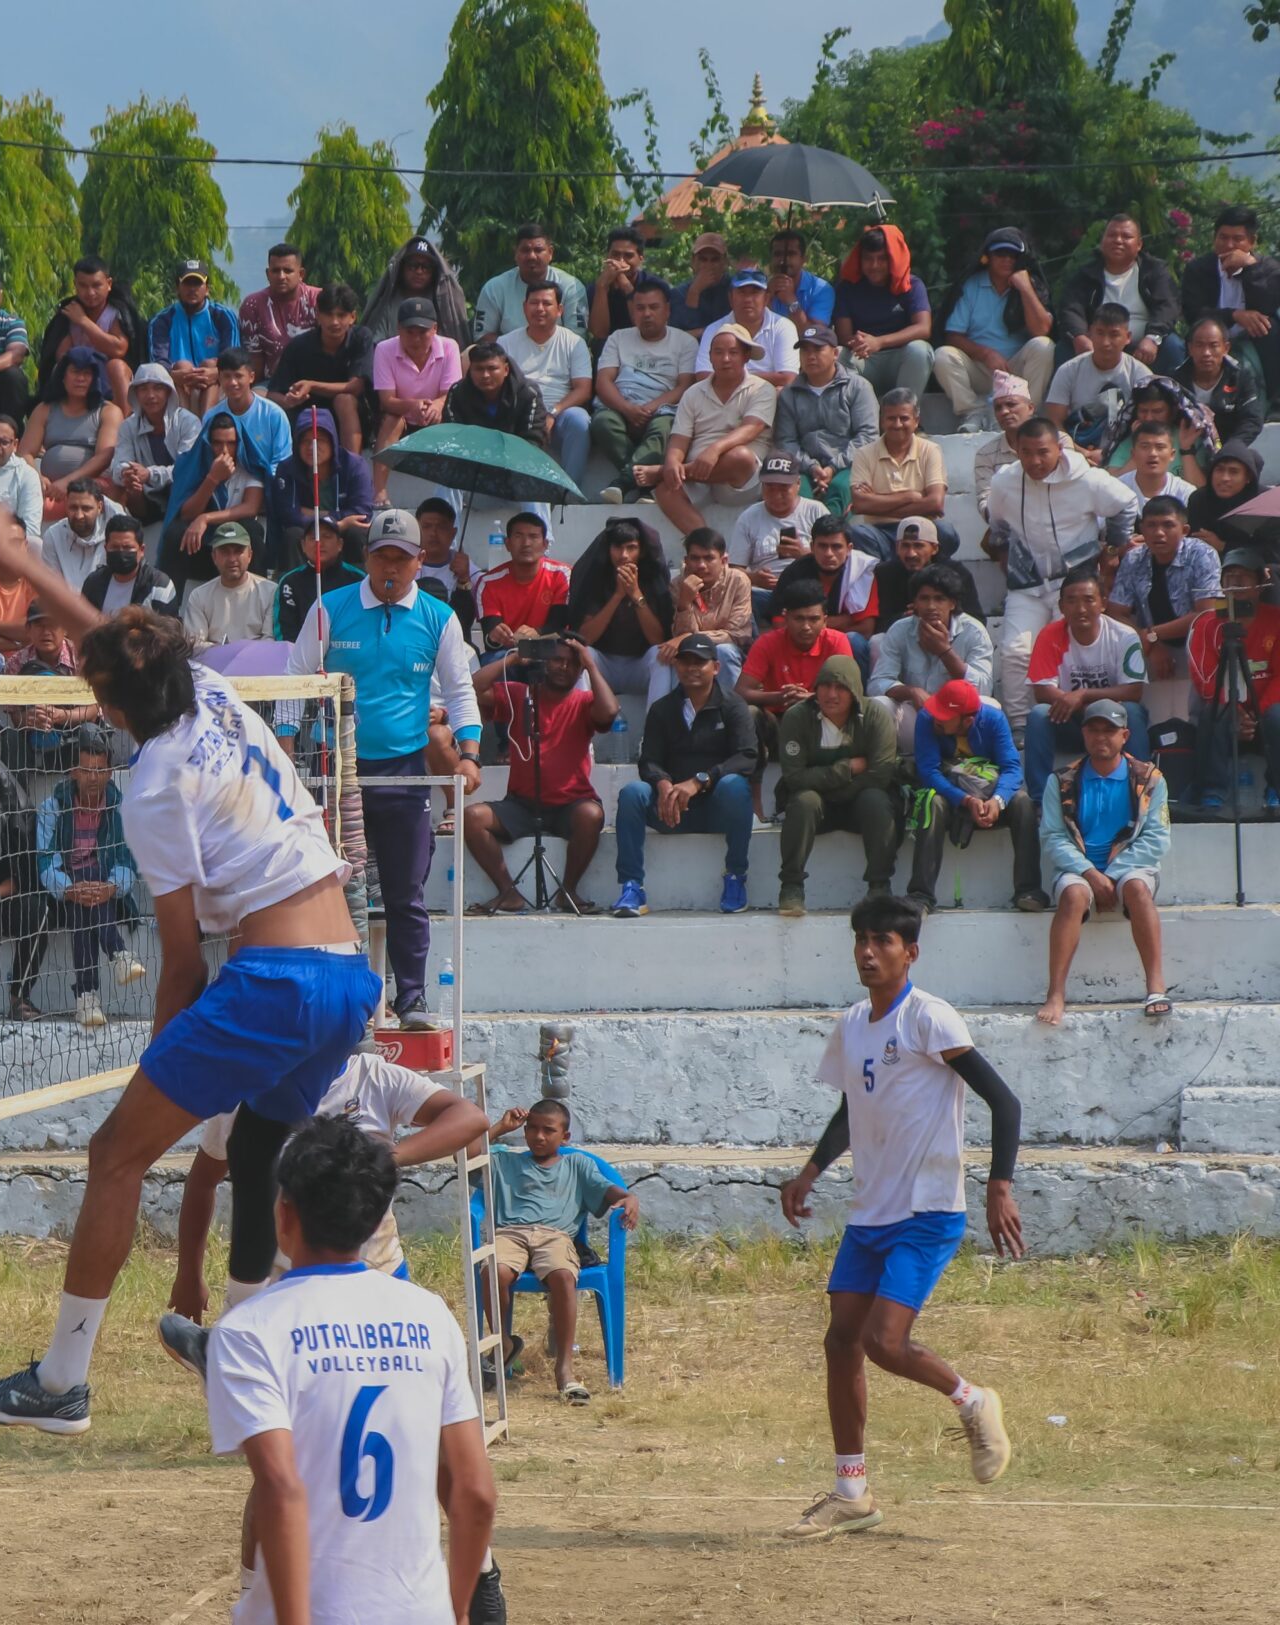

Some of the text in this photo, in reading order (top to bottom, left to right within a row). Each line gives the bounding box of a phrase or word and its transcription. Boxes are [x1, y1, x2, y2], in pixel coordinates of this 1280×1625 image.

[242, 745, 294, 823] 7
[863, 1058, 875, 1093] 5
[290, 1321, 431, 1354] PUTALIBAZAR
[307, 1354, 423, 1374] VOLLEYBALL
[340, 1385, 393, 1522] 6
